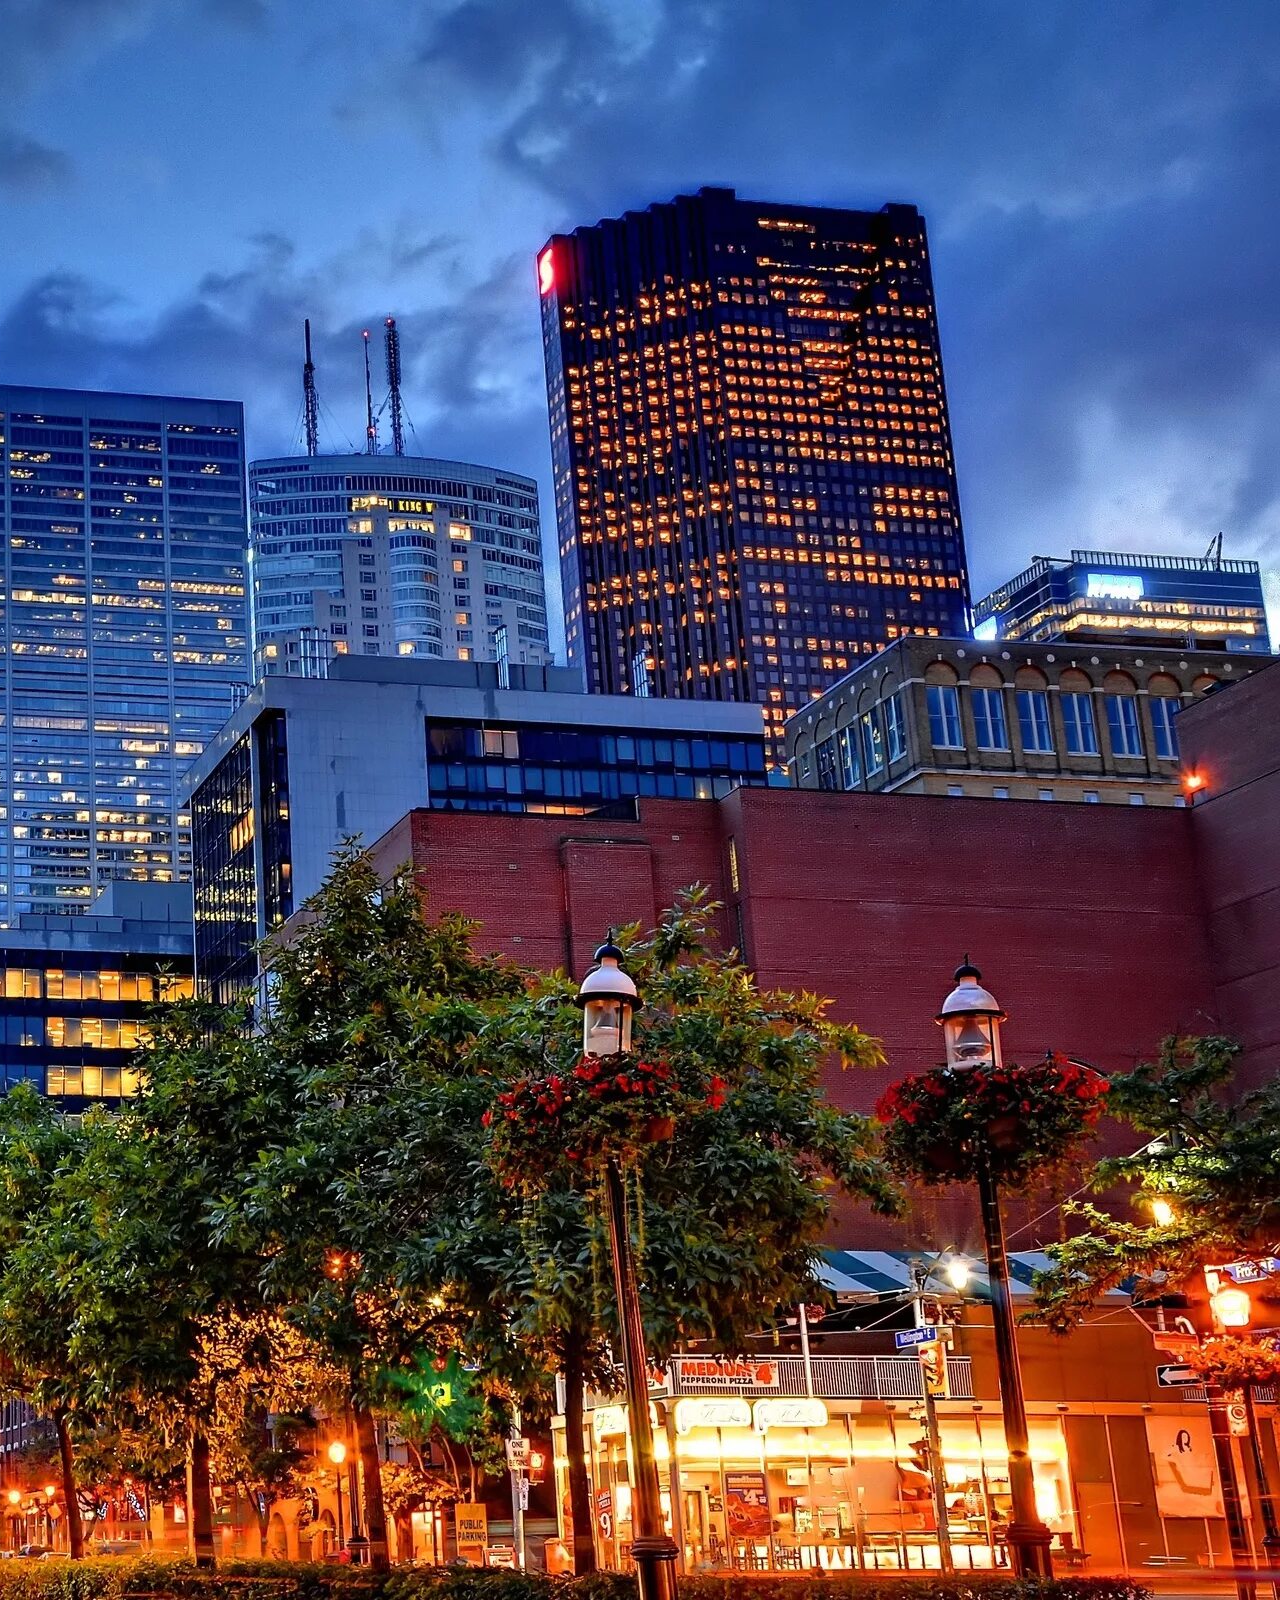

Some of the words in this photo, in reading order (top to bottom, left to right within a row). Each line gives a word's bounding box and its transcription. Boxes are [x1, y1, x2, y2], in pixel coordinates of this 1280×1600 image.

[399, 500, 422, 512] KING
[680, 1361, 753, 1378] MEDIUM
[680, 1376, 728, 1384] PEPPERONI
[729, 1377, 754, 1385] PIZZA
[511, 1440, 524, 1449] ONE
[460, 1519, 483, 1530] PUBLIC
[458, 1531, 486, 1542] PARKING
